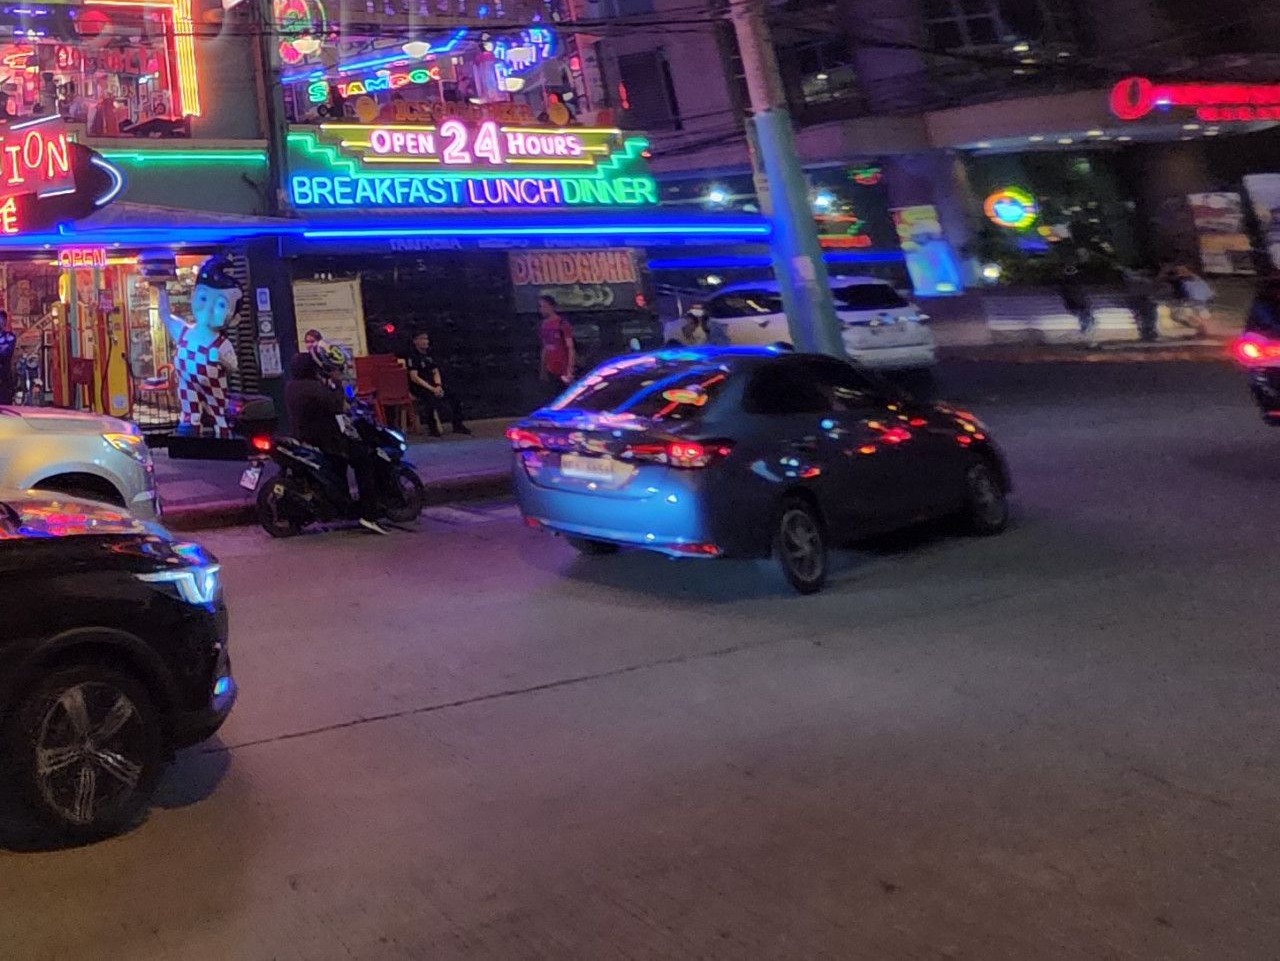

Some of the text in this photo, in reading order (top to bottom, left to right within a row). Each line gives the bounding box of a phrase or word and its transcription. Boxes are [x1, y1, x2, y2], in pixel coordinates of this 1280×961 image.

[371, 121, 582, 165] OPEN 24 HOURS
[292, 176, 657, 205] BREAKFAST LUNCH DINNER
[60, 248, 106, 268] OPEN
